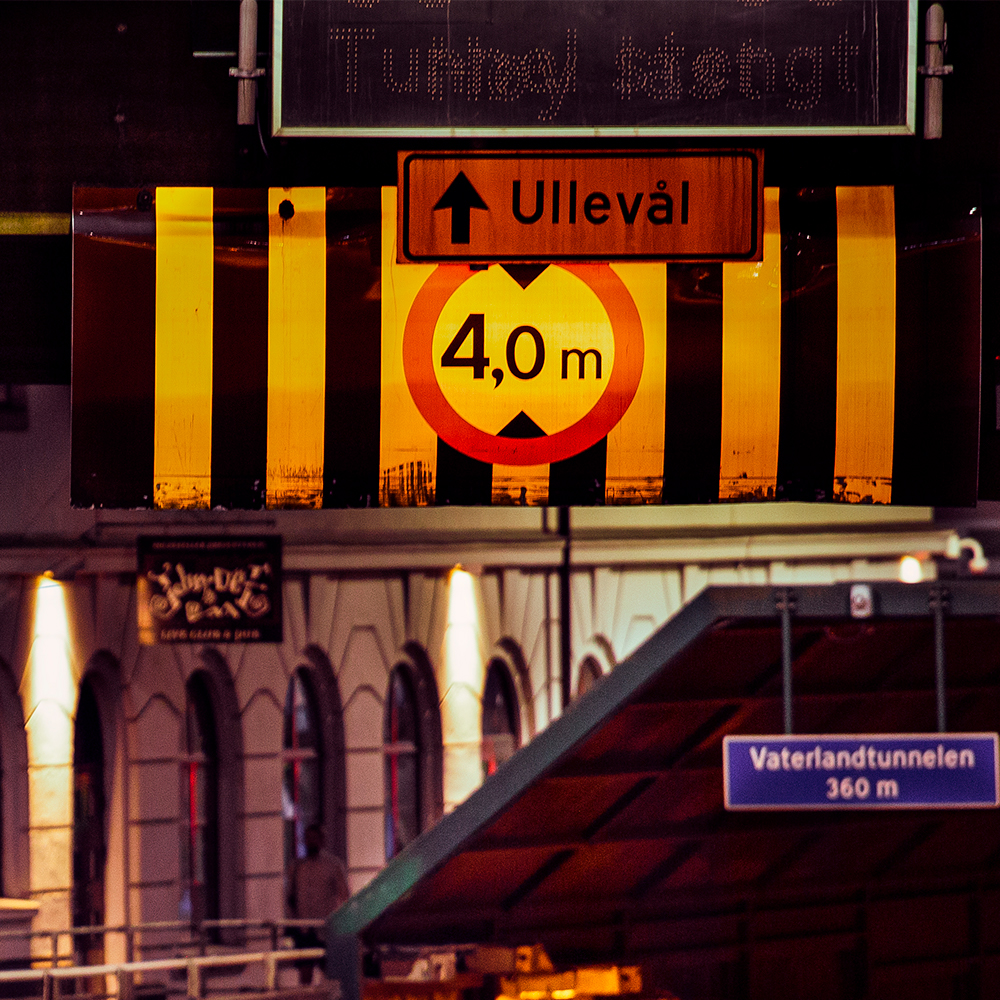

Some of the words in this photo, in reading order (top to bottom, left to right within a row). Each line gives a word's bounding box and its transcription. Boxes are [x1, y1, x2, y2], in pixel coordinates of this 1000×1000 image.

[511, 179, 690, 227] Ullevål
[440, 312, 546, 389] 4,0
[562, 348, 603, 380] m
[749, 744, 975, 771] Vaterlandtunnelen
[826, 777, 870, 800] 360
[876, 778, 900, 800] m
